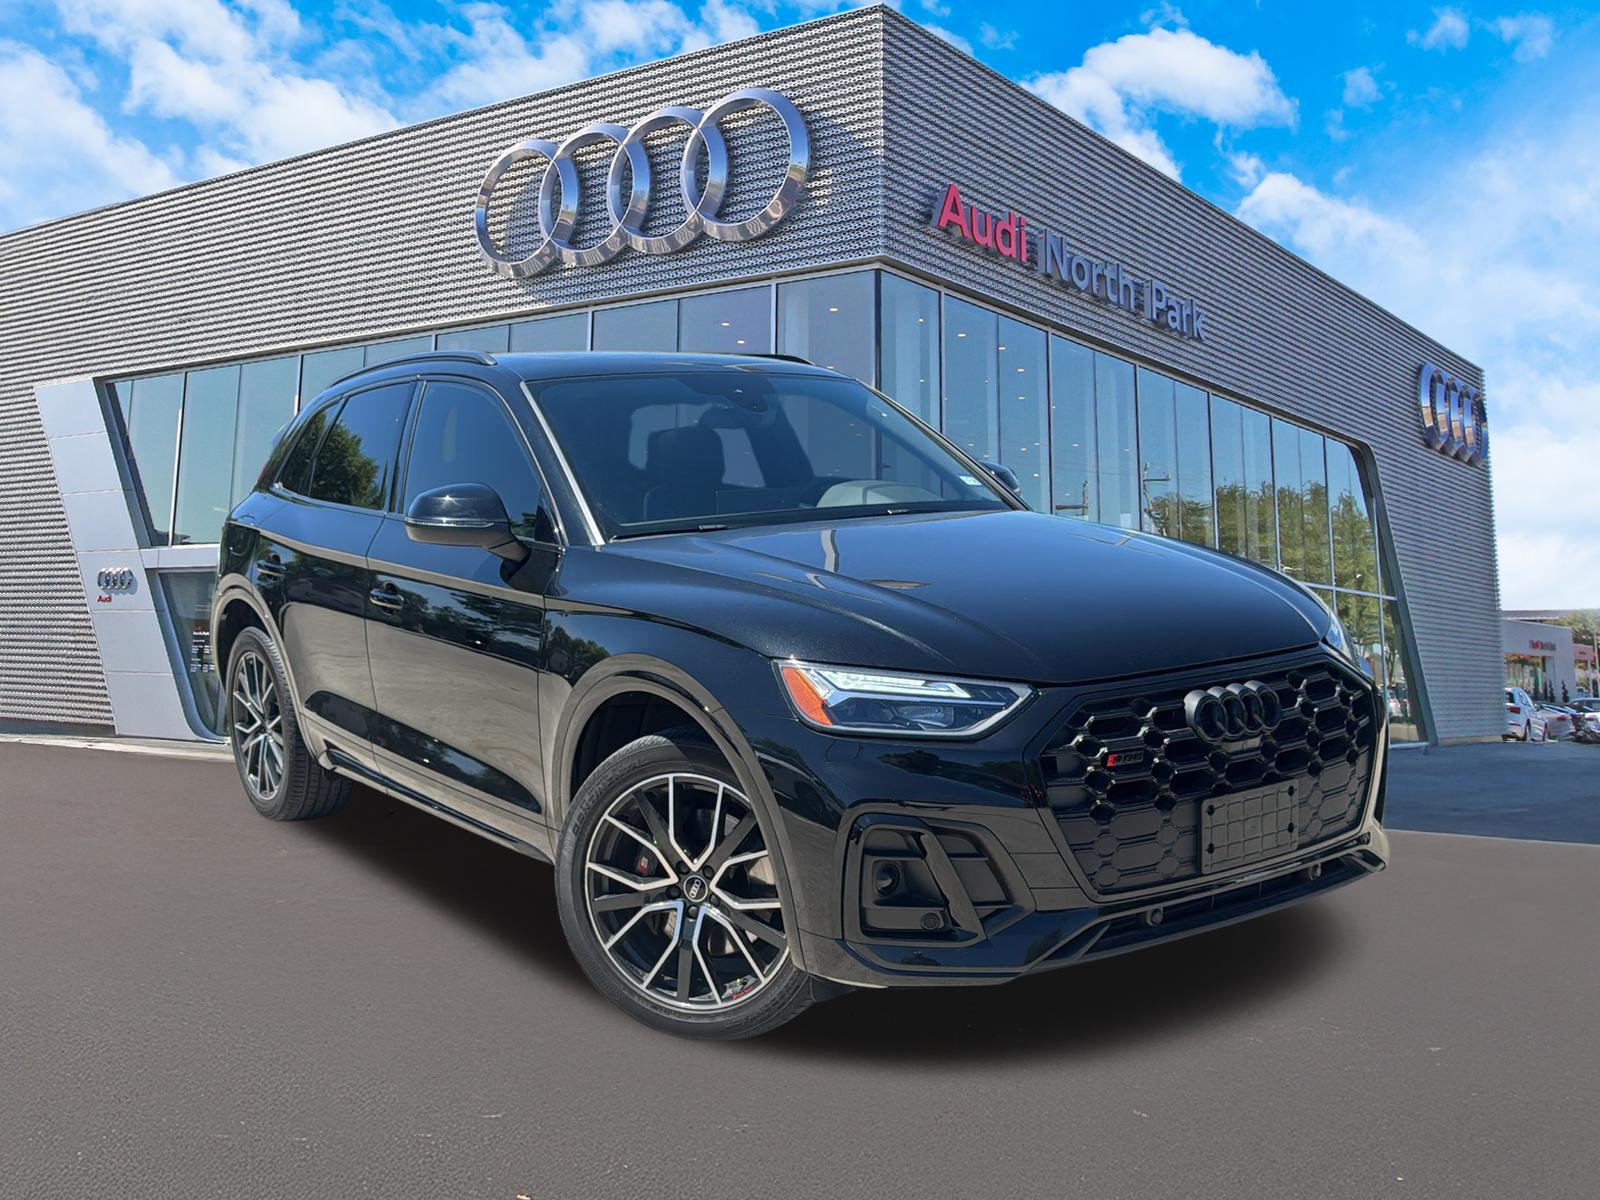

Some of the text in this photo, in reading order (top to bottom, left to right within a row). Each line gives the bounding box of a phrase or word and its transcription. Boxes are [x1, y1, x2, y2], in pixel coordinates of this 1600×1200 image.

[936, 183, 1207, 341] Audi North Park
